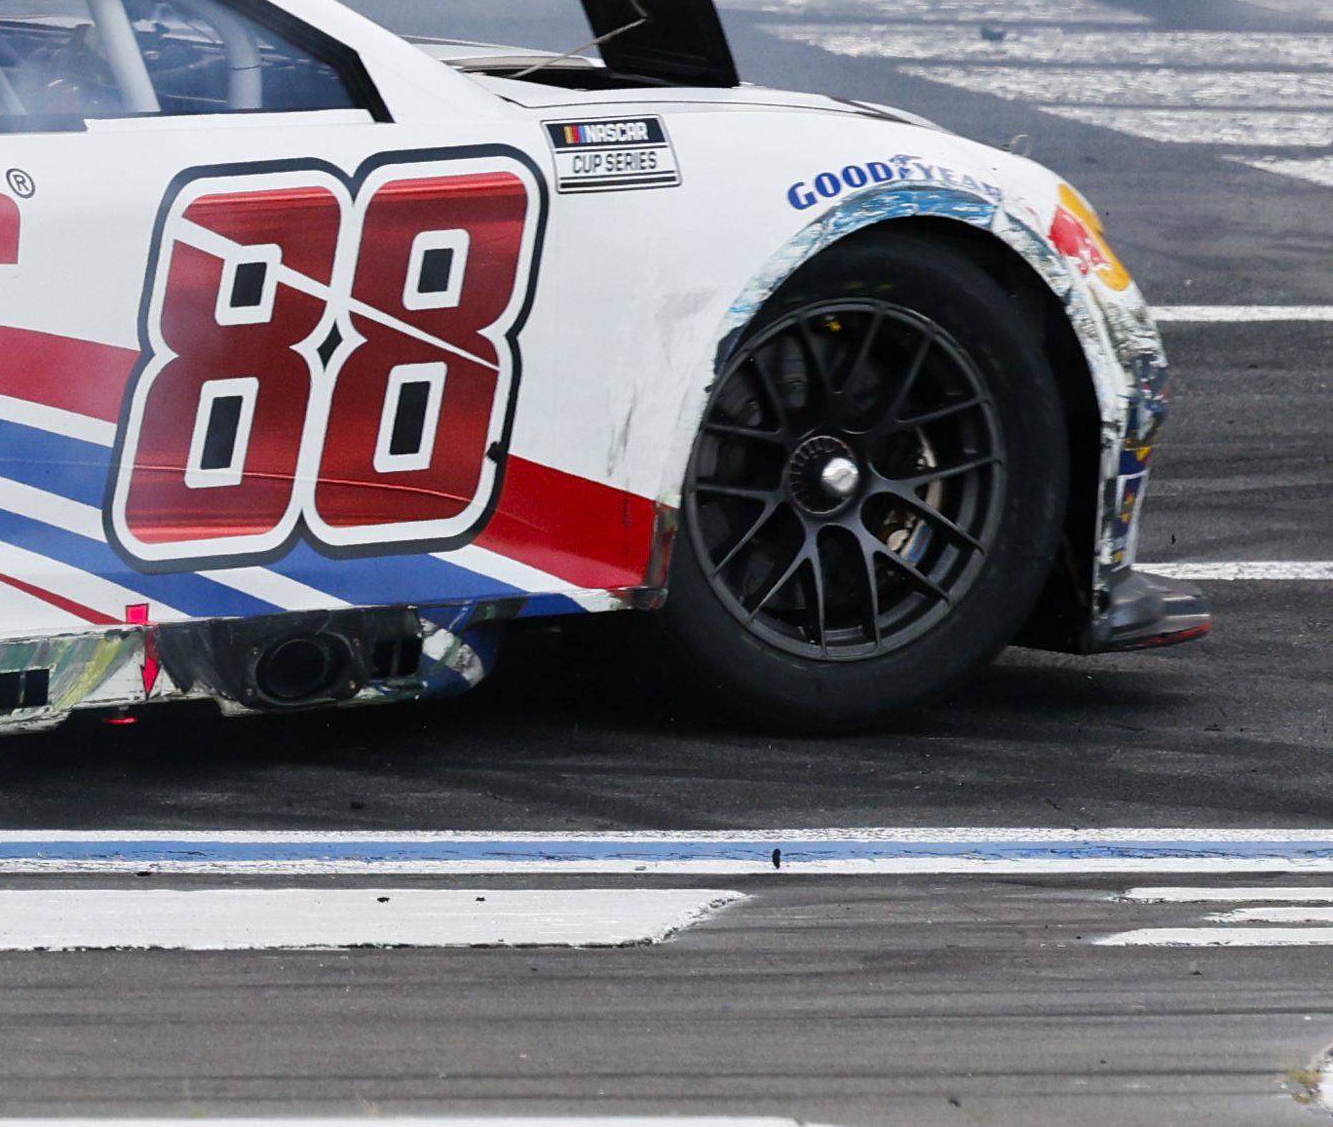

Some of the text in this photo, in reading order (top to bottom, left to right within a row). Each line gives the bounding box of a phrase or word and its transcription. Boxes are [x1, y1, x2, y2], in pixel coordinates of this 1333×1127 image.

[583, 121, 649, 143] NASCAR
[572, 150, 658, 174] CUP SERIES
[103, 143, 550, 575] 88
